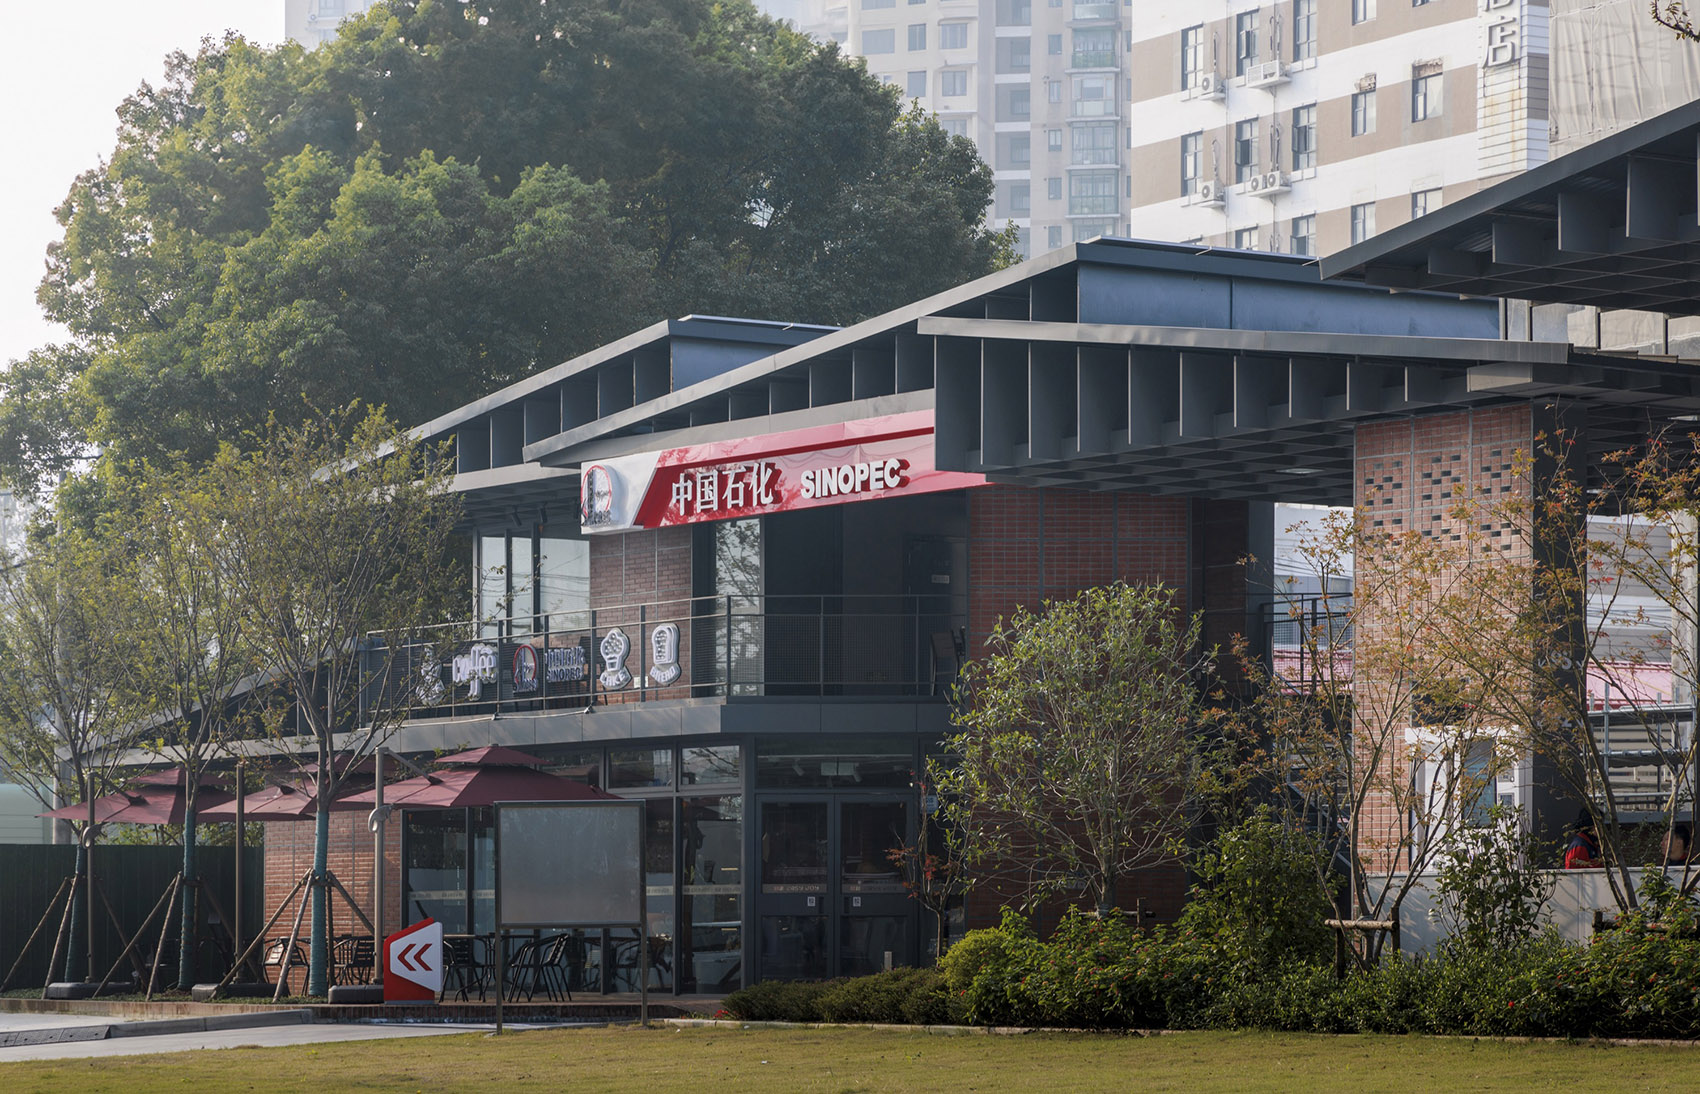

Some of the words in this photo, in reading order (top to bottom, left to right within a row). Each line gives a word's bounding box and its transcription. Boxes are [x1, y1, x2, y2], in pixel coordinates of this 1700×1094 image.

[1483, 0, 1515, 68] 店
[671, 461, 774, 516] 中国石化
[800, 457, 903, 499] SINOPEC
[547, 665, 583, 682] SINOPEC
[600, 669, 627, 686] CAKE
[650, 665, 676, 683] BREAD
